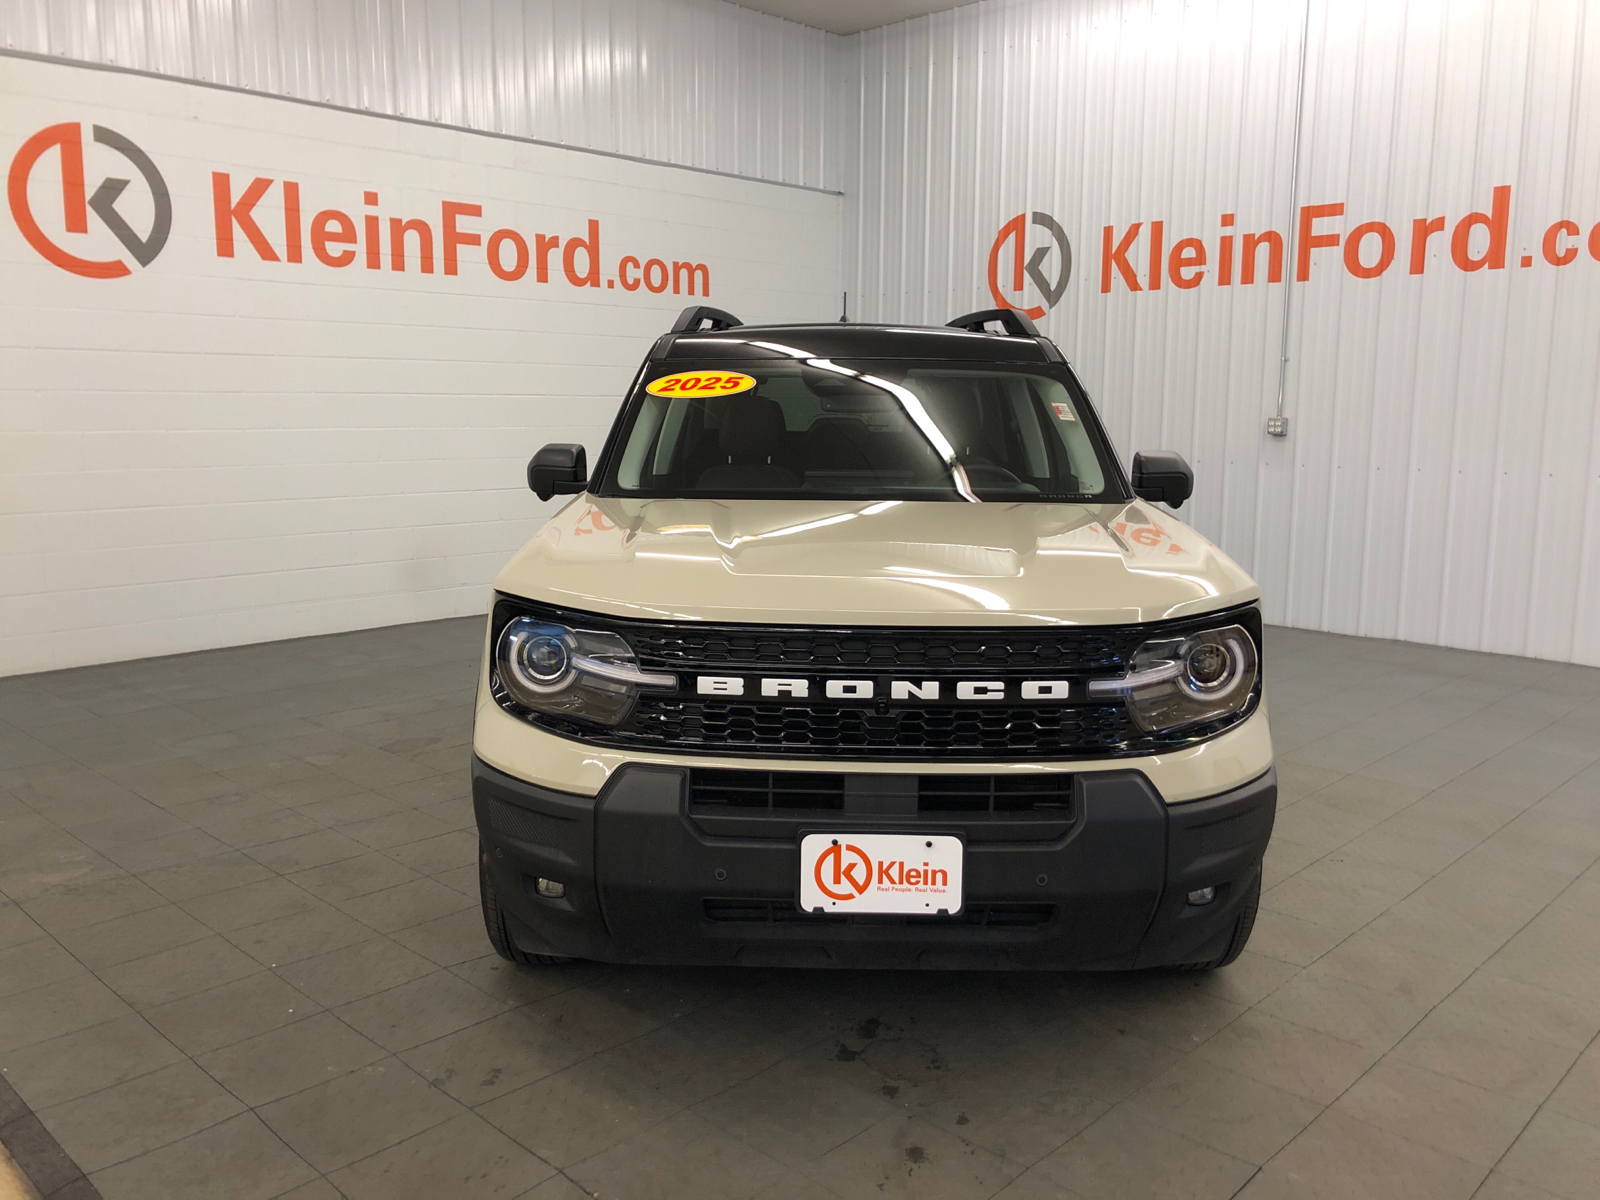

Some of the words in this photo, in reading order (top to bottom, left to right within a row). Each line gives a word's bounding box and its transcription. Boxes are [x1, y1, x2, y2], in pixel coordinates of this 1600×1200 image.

[211, 170, 711, 297] KleinFord.com
[656, 376, 744, 392] 2025
[696, 675, 1069, 701] BRONCO
[877, 860, 948, 887] Klein
